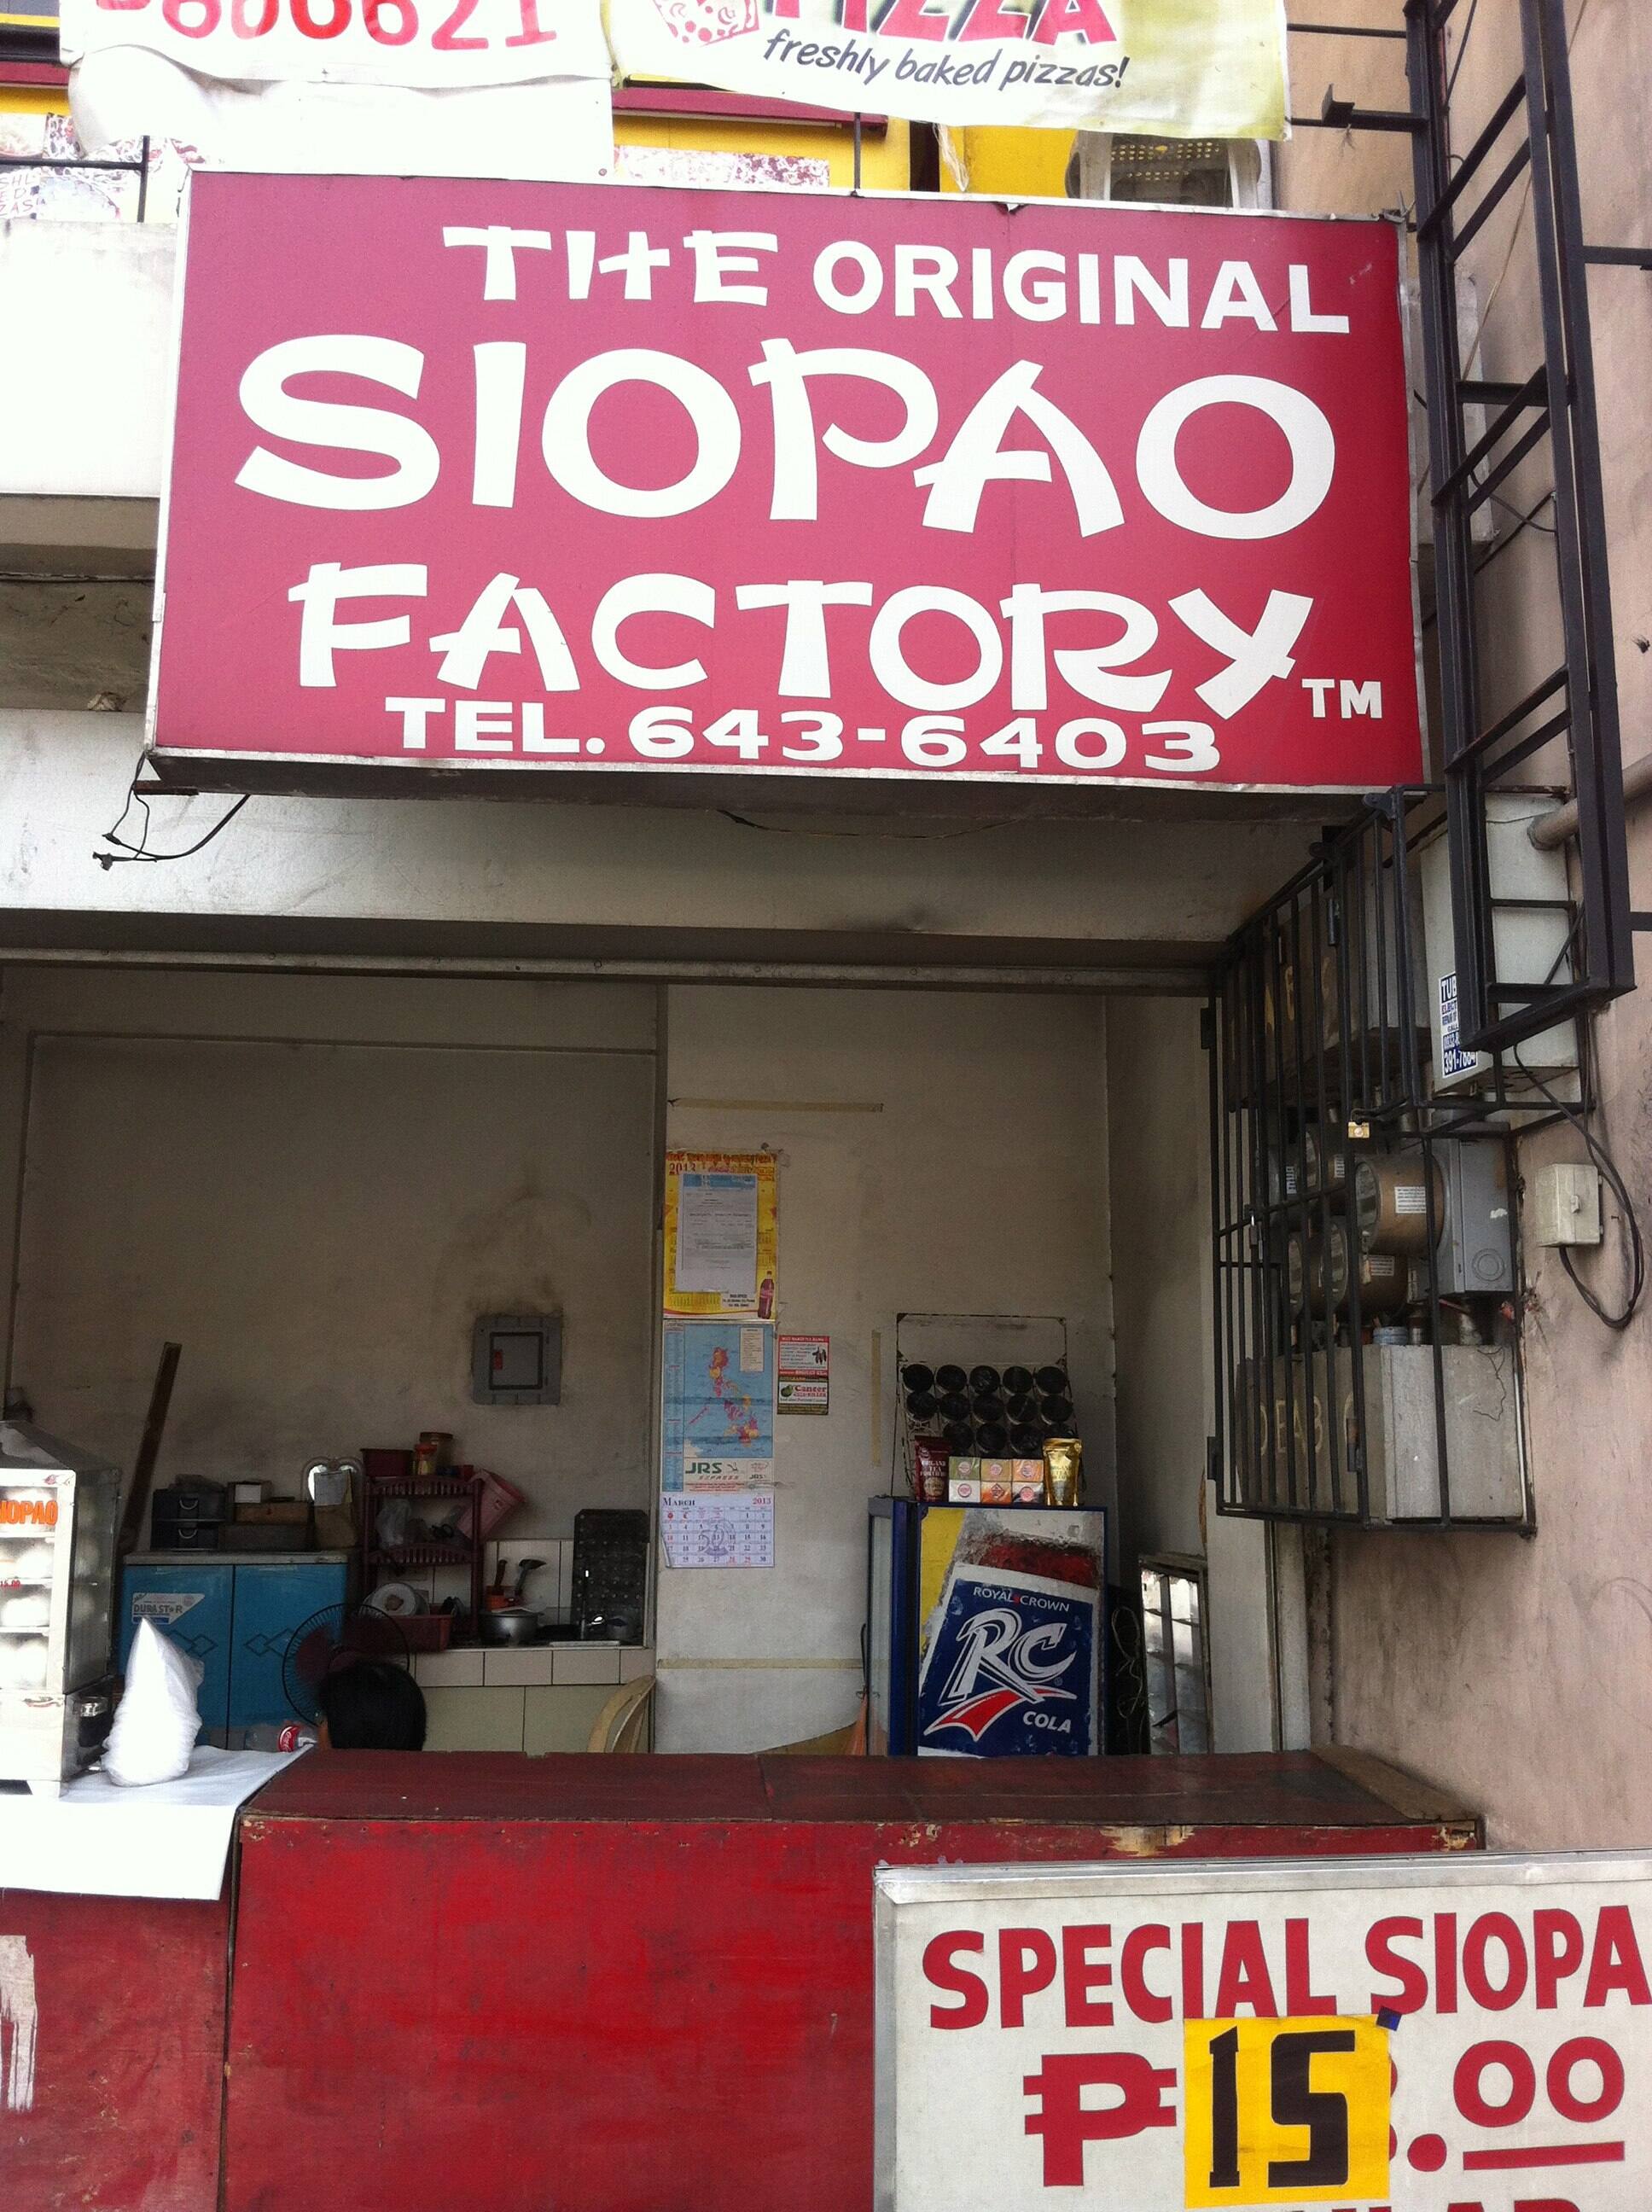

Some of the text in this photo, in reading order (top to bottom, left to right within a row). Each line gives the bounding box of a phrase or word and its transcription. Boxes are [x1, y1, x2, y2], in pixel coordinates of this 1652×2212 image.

[762, 28, 1129, 90] freshly baked pizzas!
[442, 224, 1350, 334] THE ORIGINAL
[234, 334, 1336, 540] SIOPAO
[288, 562, 1314, 721] FACTORY
[385, 696, 1221, 772] TEL. 643-6403
[685, 1462, 723, 1474] JRS
[752, 1497, 771, 1505] 2013
[0, 1500, 58, 1526] IOPAO
[973, 1586, 1070, 1612] ROYAL CROWN
[938, 1608, 1078, 1706] RC
[1022, 1711, 1072, 1733] COLA
[922, 1906, 1652, 2029] SPECIAL SIOPA
